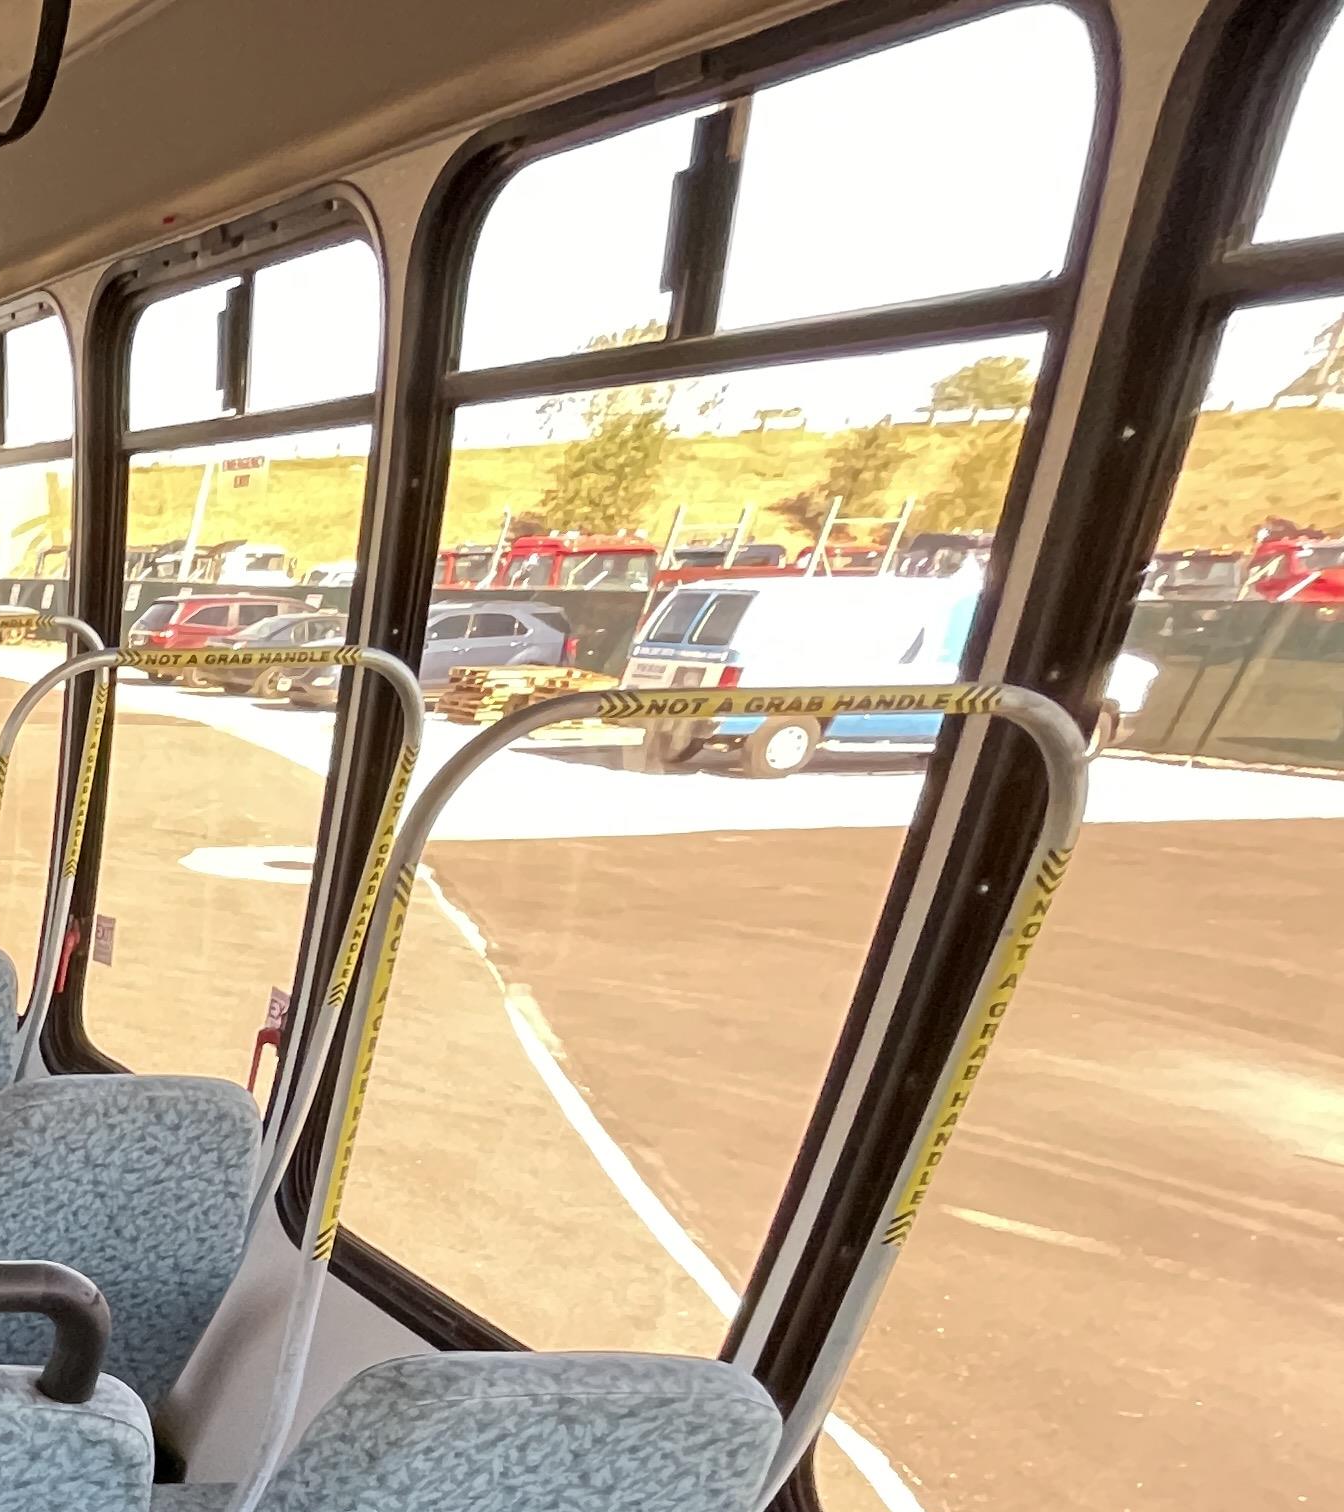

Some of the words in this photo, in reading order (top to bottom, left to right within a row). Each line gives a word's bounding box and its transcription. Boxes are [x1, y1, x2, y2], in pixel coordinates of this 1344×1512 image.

[144, 653, 182, 665] NOT
[186, 653, 198, 665] A
[204, 652, 253, 665] GRAB
[258, 650, 331, 664] HANDLE
[647, 697, 710, 716] NOT
[714, 697, 735, 715] A
[744, 695, 824, 713] GRAB
[833, 692, 952, 712] HANDLE
[391, 777, 407, 818] NOT
[383, 824, 394, 836] A
[366, 842, 390, 896] GRAB
[341, 903, 371, 979] HANDLE
[1014, 898, 1052, 962] NOT
[999, 972, 1018, 991] A
[962, 1001, 1008, 1082] GRAB
[908, 1090, 971, 1206] HANDLE
